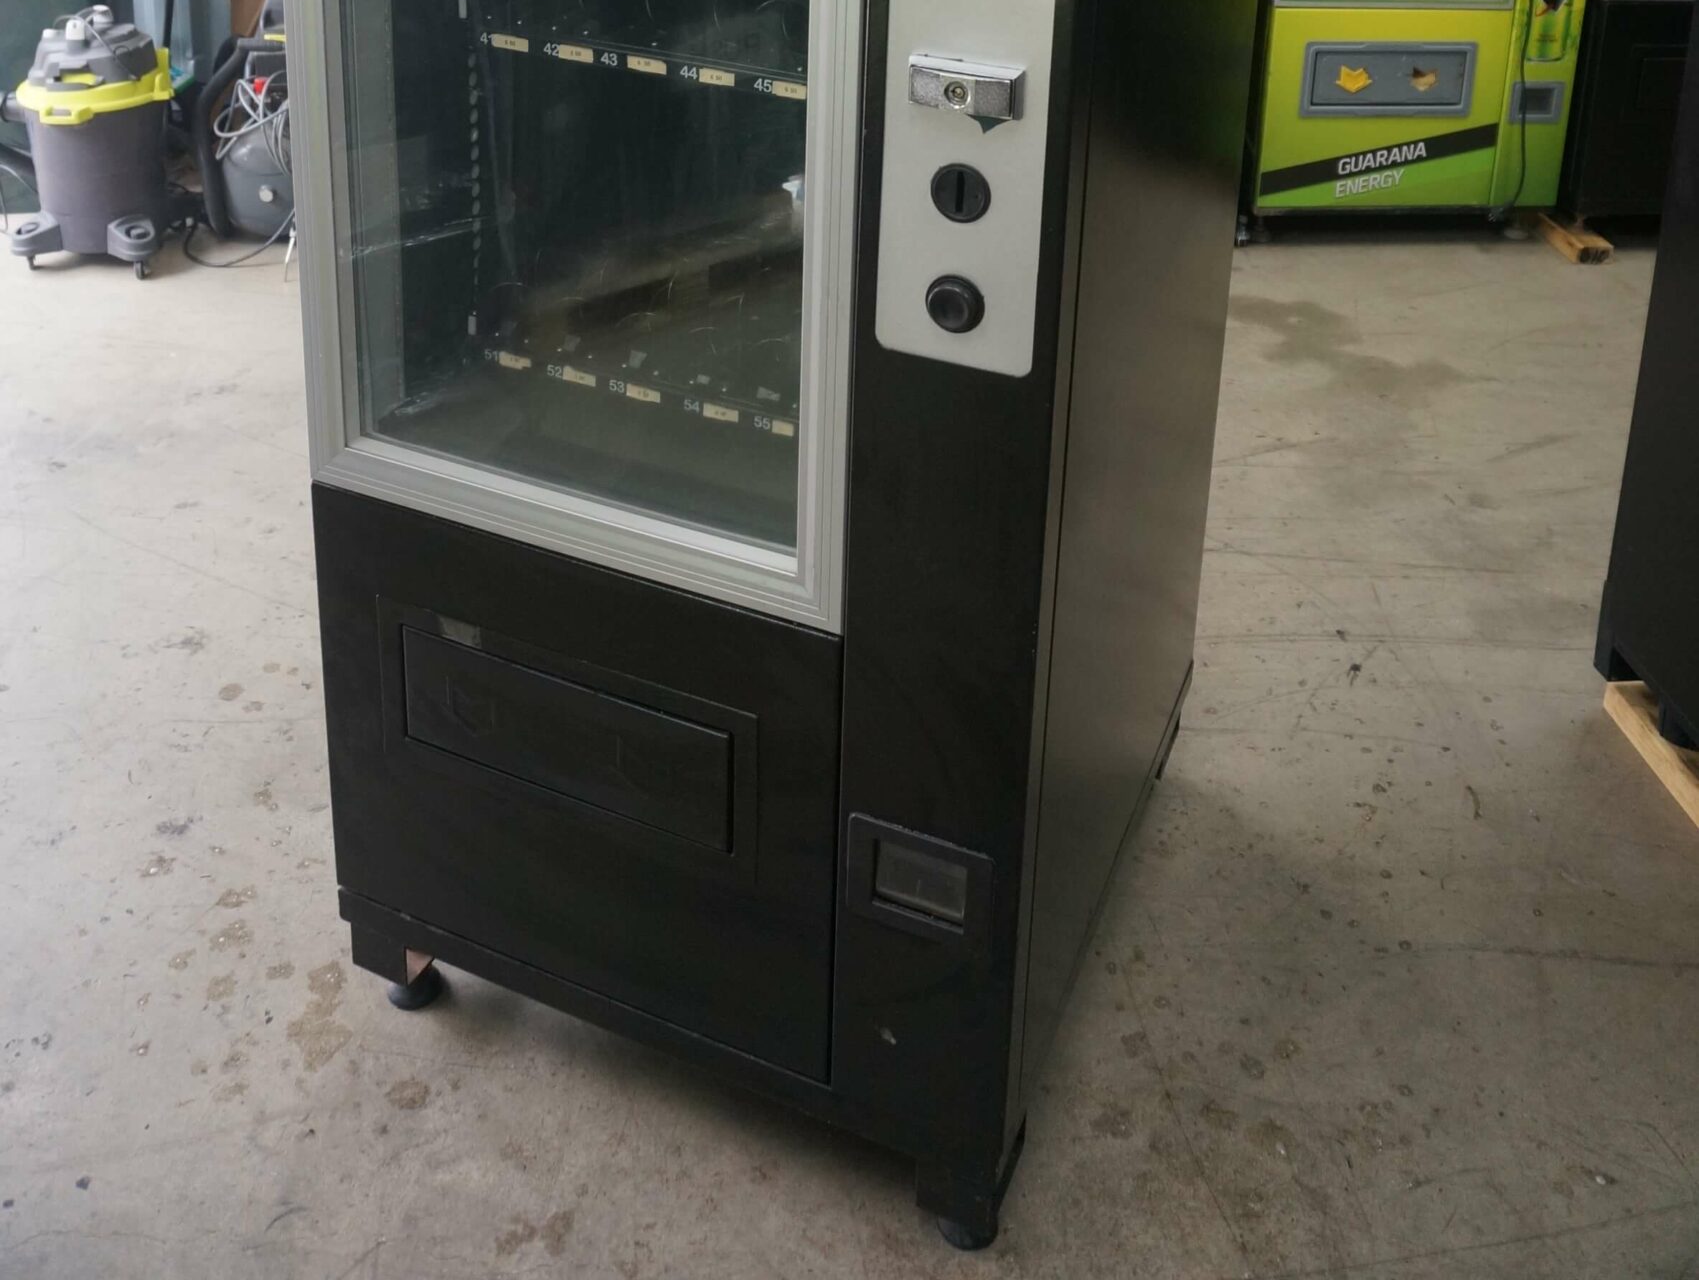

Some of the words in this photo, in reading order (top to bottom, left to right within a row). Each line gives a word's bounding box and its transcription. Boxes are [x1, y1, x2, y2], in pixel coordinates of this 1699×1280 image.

[543, 42, 560, 56] 42
[600, 52, 618, 66] 43
[680, 65, 698, 80] 44
[754, 78, 772, 93] 45
[1337, 142, 1427, 176] GUARANA
[1335, 169, 1405, 198] ENERGY
[547, 364, 562, 378] 52
[609, 379, 625, 393] 53
[683, 399, 700, 413] 54
[754, 416, 771, 430] 55
